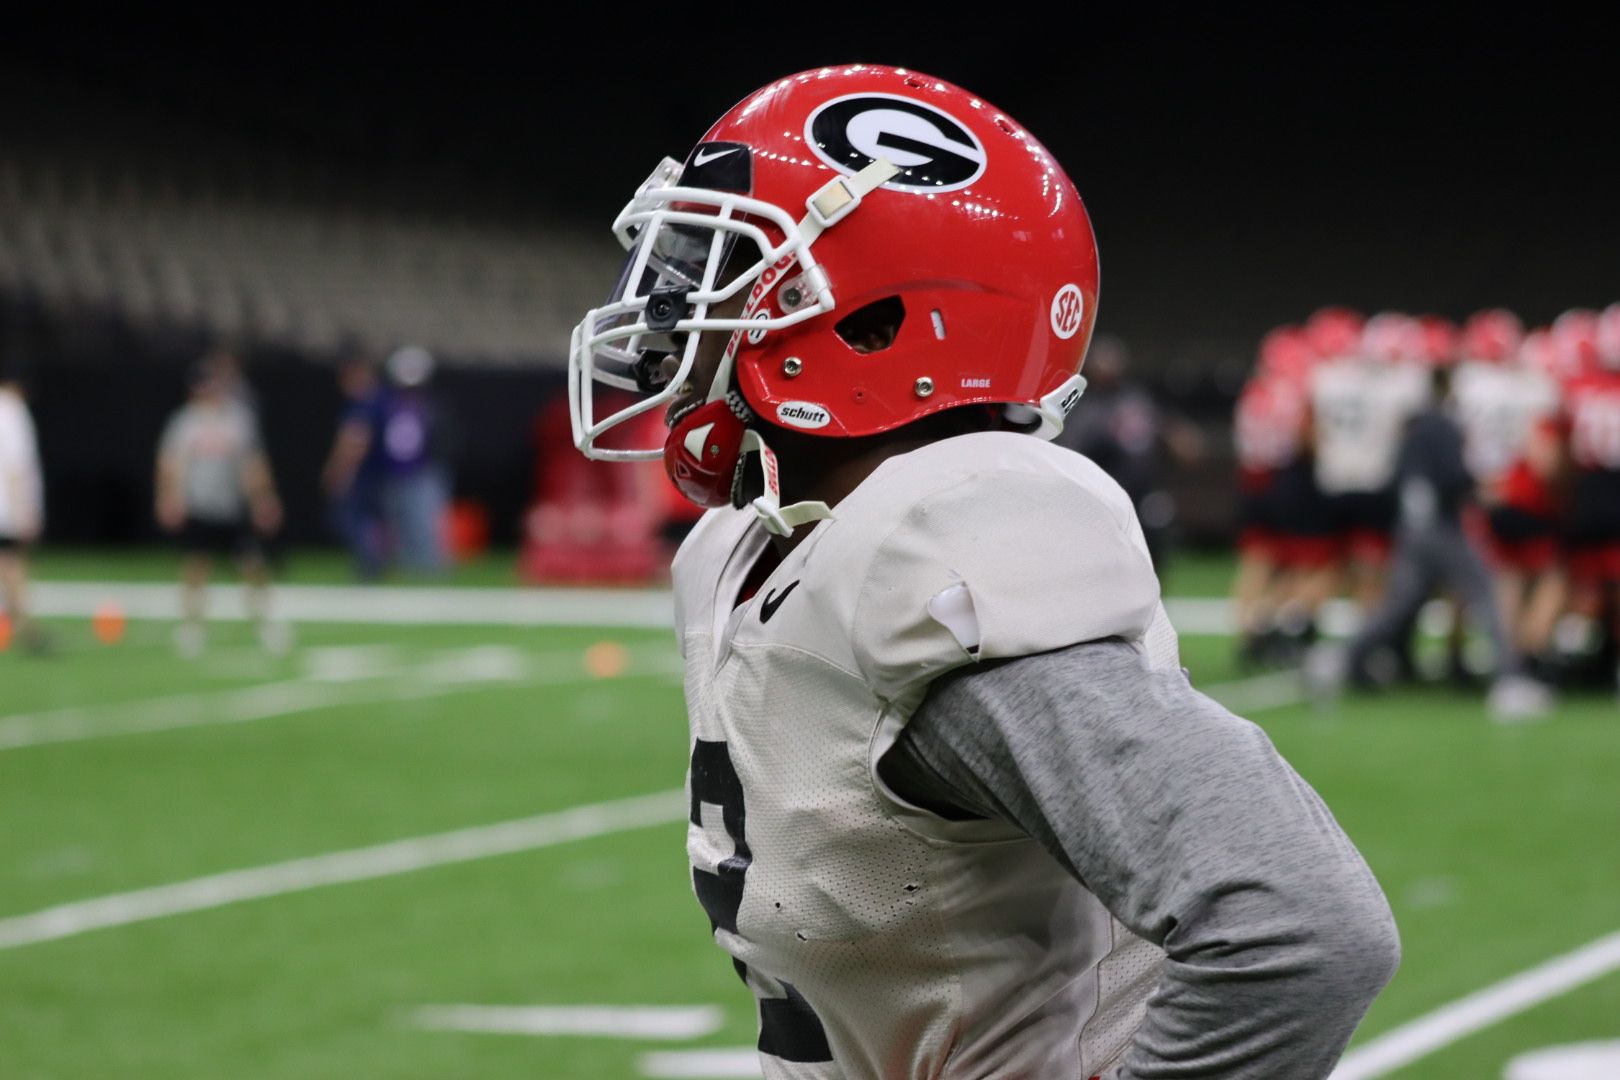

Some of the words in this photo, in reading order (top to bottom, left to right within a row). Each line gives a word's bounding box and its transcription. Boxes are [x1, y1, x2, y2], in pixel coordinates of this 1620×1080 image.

[811, 97, 981, 187] G
[727, 250, 797, 357] BULDOG
[1056, 290, 1080, 333] SEC
[960, 378, 991, 388] LARGE
[780, 406, 825, 423] schutt
